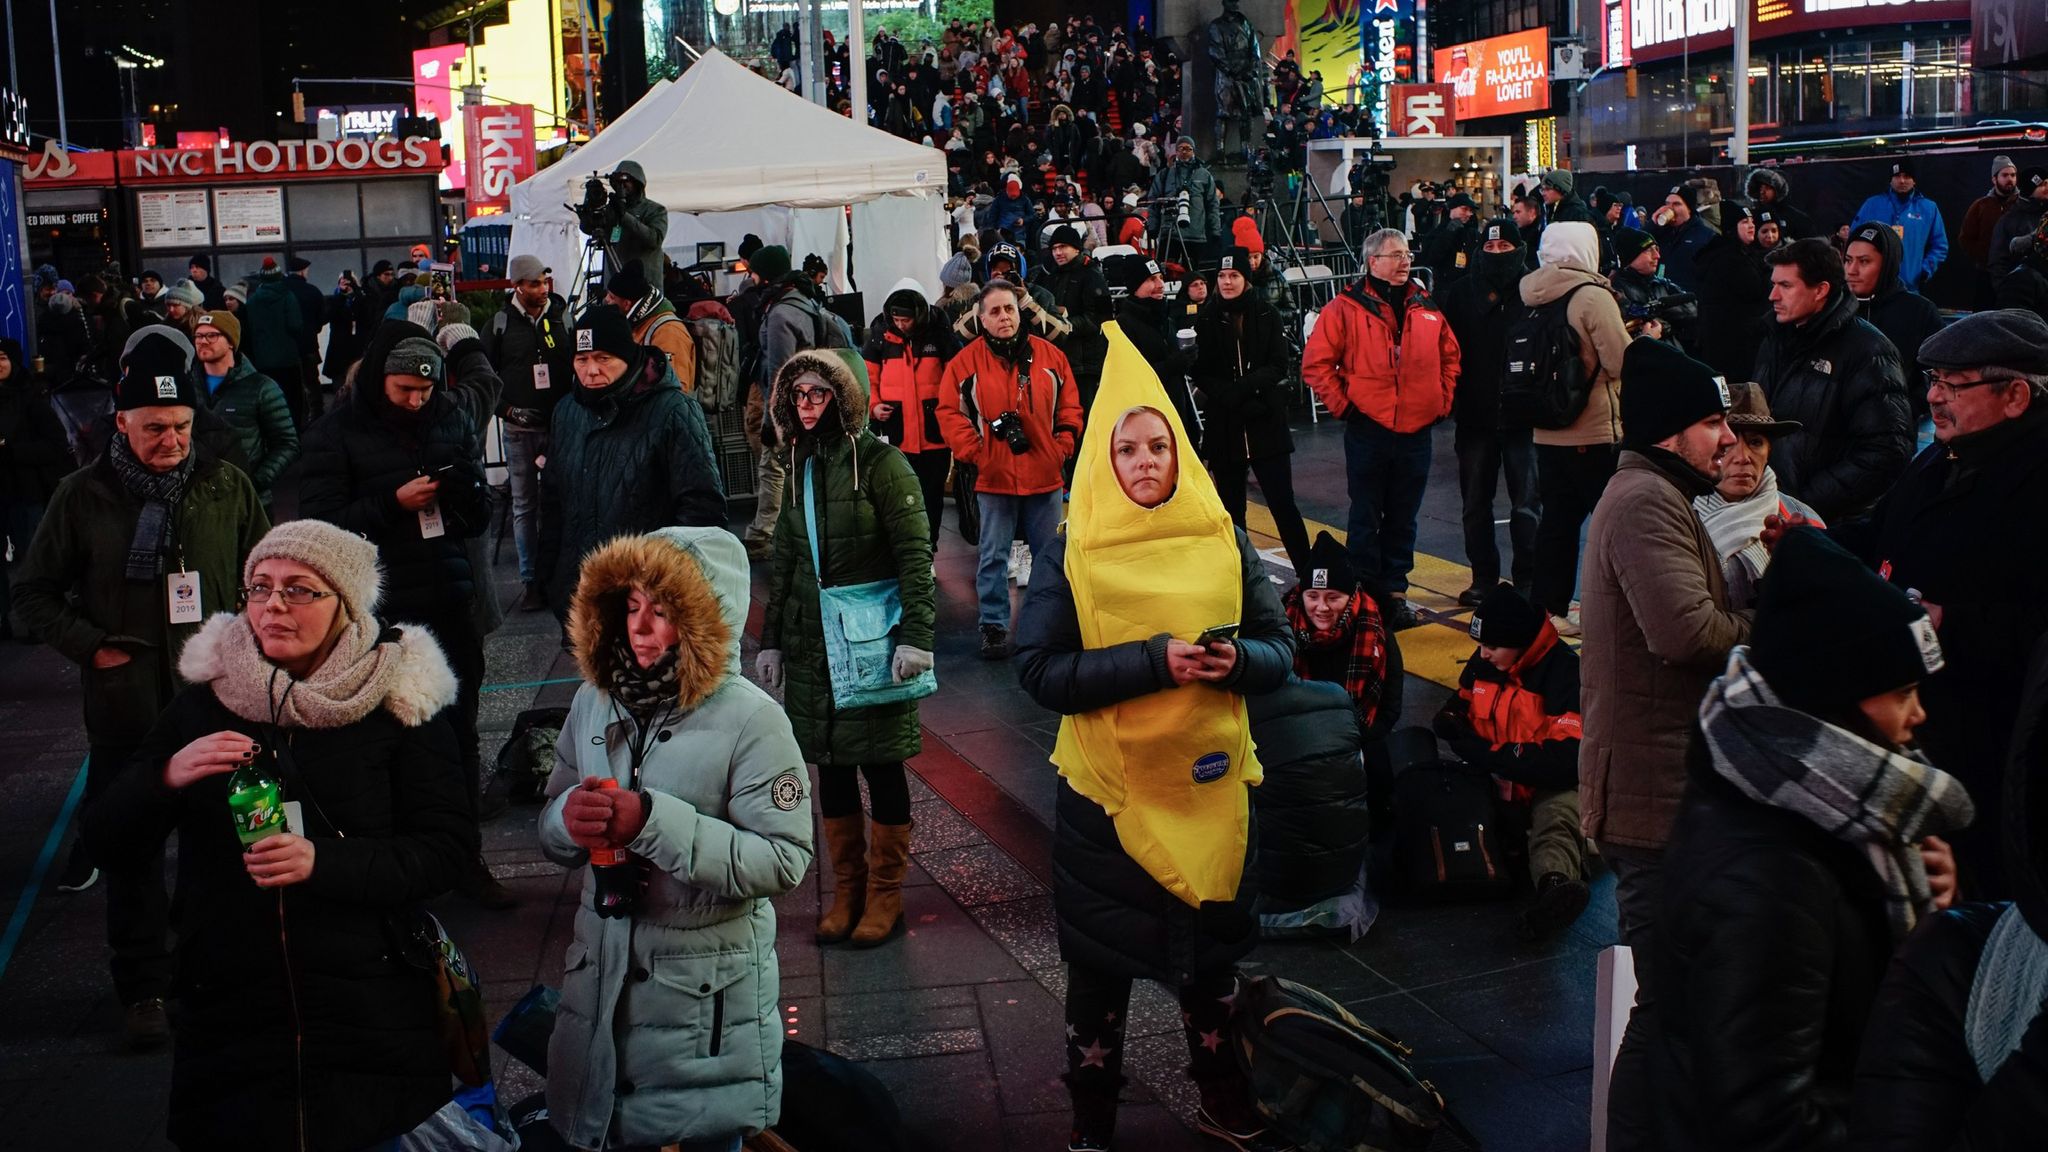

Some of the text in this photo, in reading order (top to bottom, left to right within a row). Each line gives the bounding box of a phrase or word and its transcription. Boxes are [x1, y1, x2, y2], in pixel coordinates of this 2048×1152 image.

[769, 3, 792, 12] North
[1497, 45, 1531, 67] YOU'LL
[1486, 61, 1545, 86] FA-LA-LA-LA
[1496, 80, 1533, 102] LOVE IT
[1541, 120, 1549, 165] LUGGAGE
[135, 136, 427, 177] NYC HOTDOGS
[481, 112, 523, 197] tkts
[27, 212, 99, 226] ED DRINKS COFFEE
[176, 605, 196, 613] 2019
